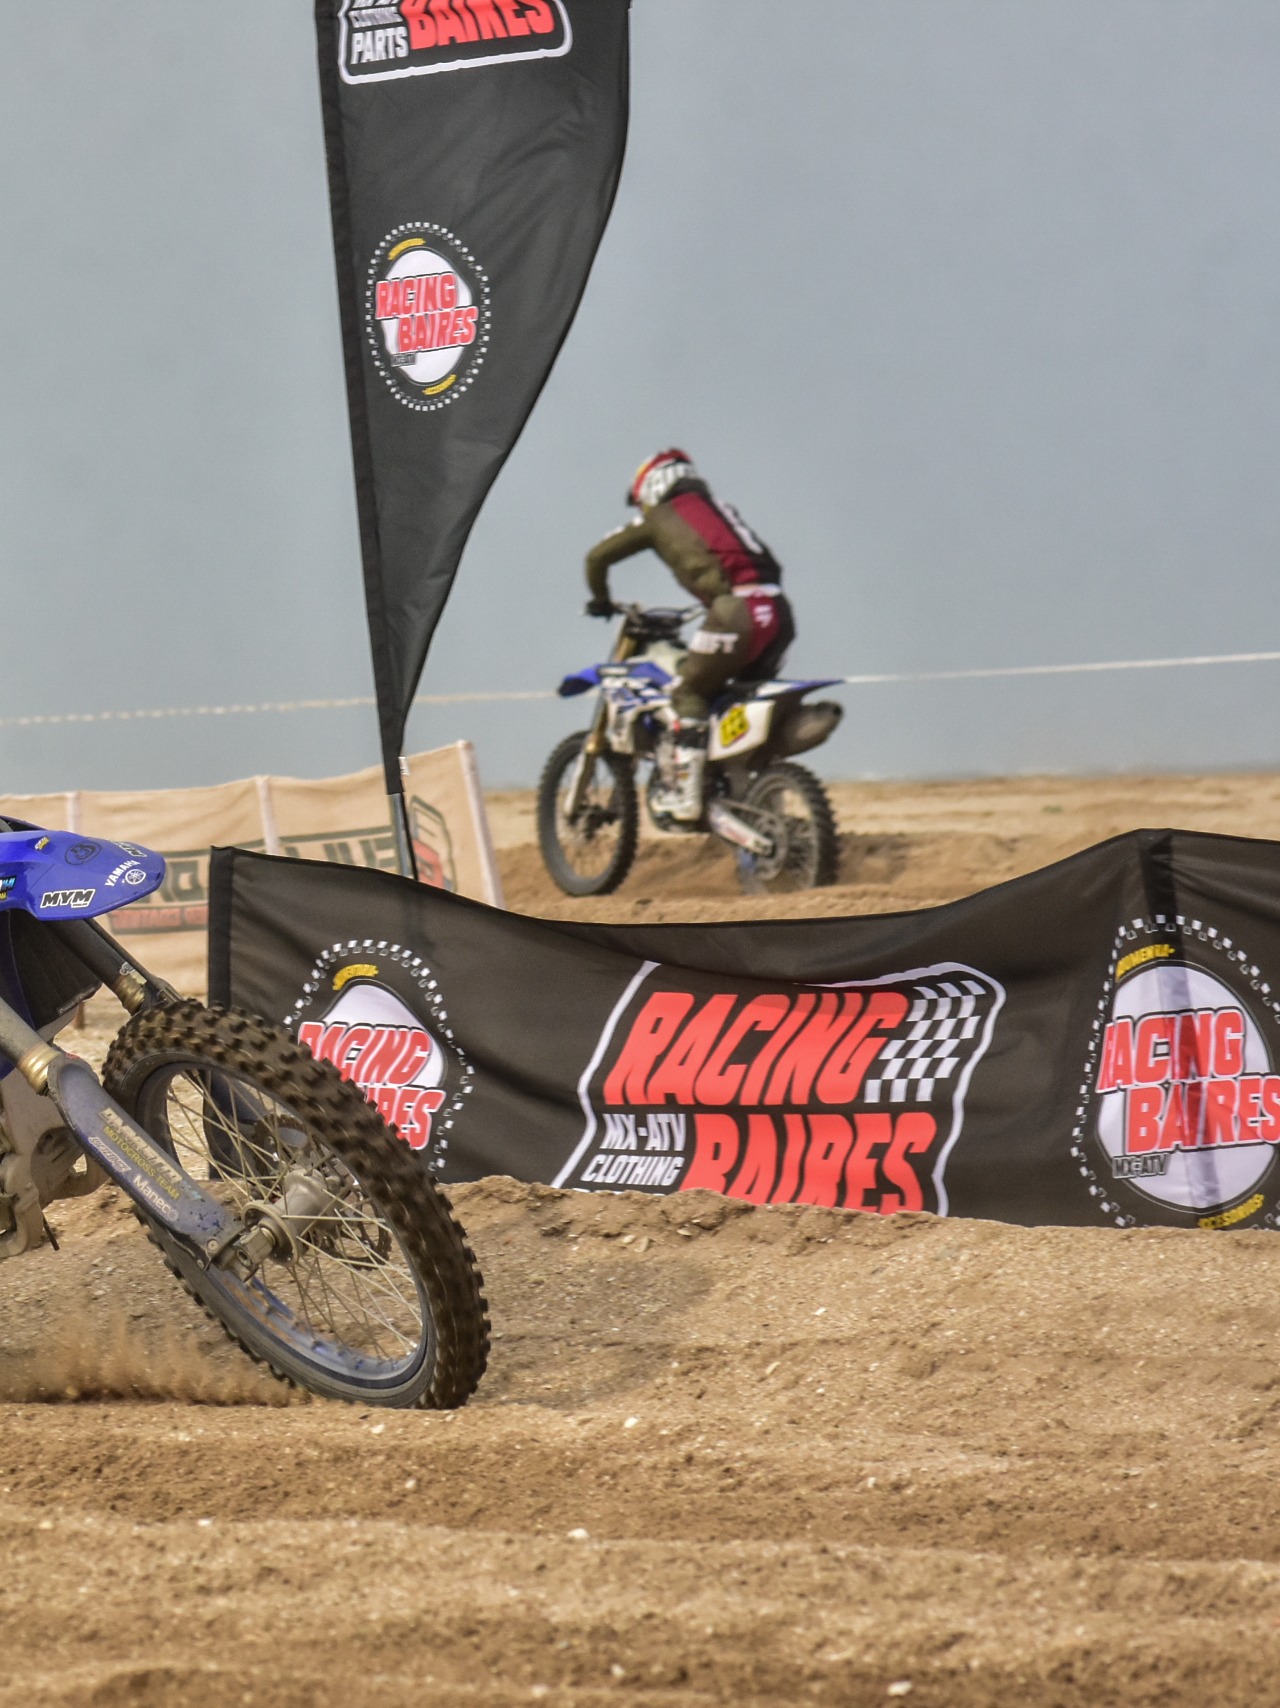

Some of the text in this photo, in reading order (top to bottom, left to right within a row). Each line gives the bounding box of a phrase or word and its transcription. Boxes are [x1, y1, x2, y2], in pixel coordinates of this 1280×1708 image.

[350, 26, 410, 64] PARTS
[375, 273, 458, 319] RACING
[398, 306, 479, 353] BAIRES
[105, 860, 141, 887] YAMAHA
[41, 889, 94, 908] MYM
[604, 990, 910, 1106] RACING
[599, 1113, 687, 1152] MX-ATV
[1126, 1075, 1280, 1155] BAIRES
[103, 1125, 157, 1177] MOTOCROSS
[155, 1173, 181, 1200] TEAM
[580, 1154, 686, 1187] CLOTHING
[680, 1111, 937, 1216] BAIRES
